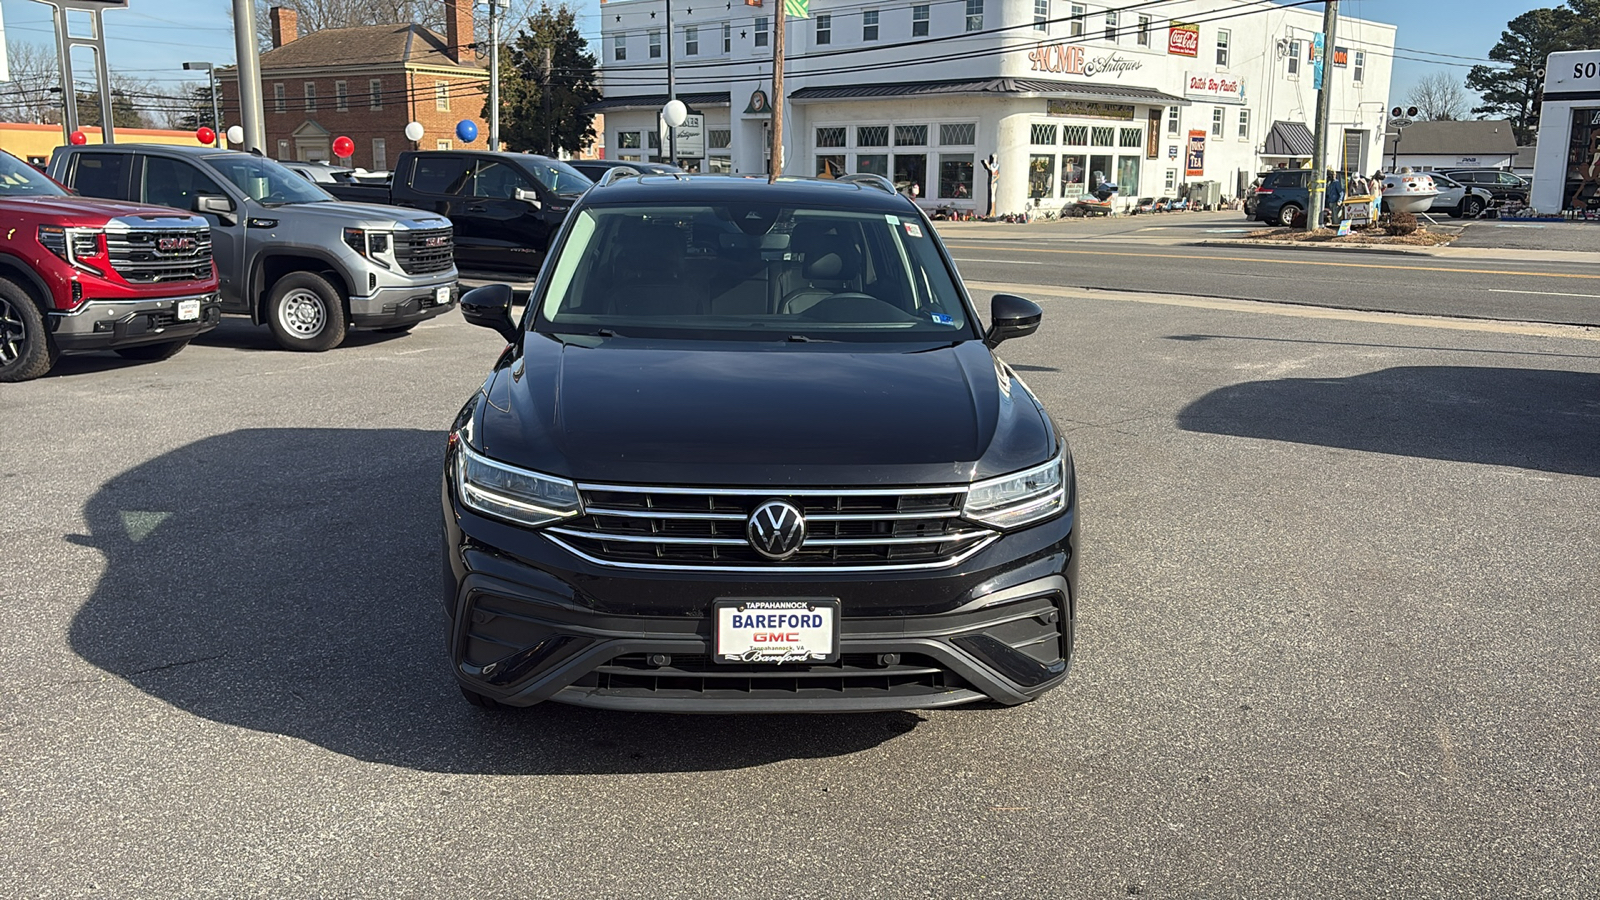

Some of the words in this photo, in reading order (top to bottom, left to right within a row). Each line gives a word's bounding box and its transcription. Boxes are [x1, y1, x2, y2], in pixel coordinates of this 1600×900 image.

[1028, 43, 1085, 75] ACME
[1084, 51, 1143, 79] Antiques
[1573, 62, 1600, 79] SO
[1190, 76, 1206, 90] Dutch
[1208, 78, 1219, 94] Boy
[1220, 79, 1237, 93] Paints
[1190, 156, 1202, 168] TEA
[159, 237, 196, 250] GMC
[732, 614, 823, 629] BAREFORD
[753, 632, 800, 642] GMC
[741, 650, 811, 665] Bareford
